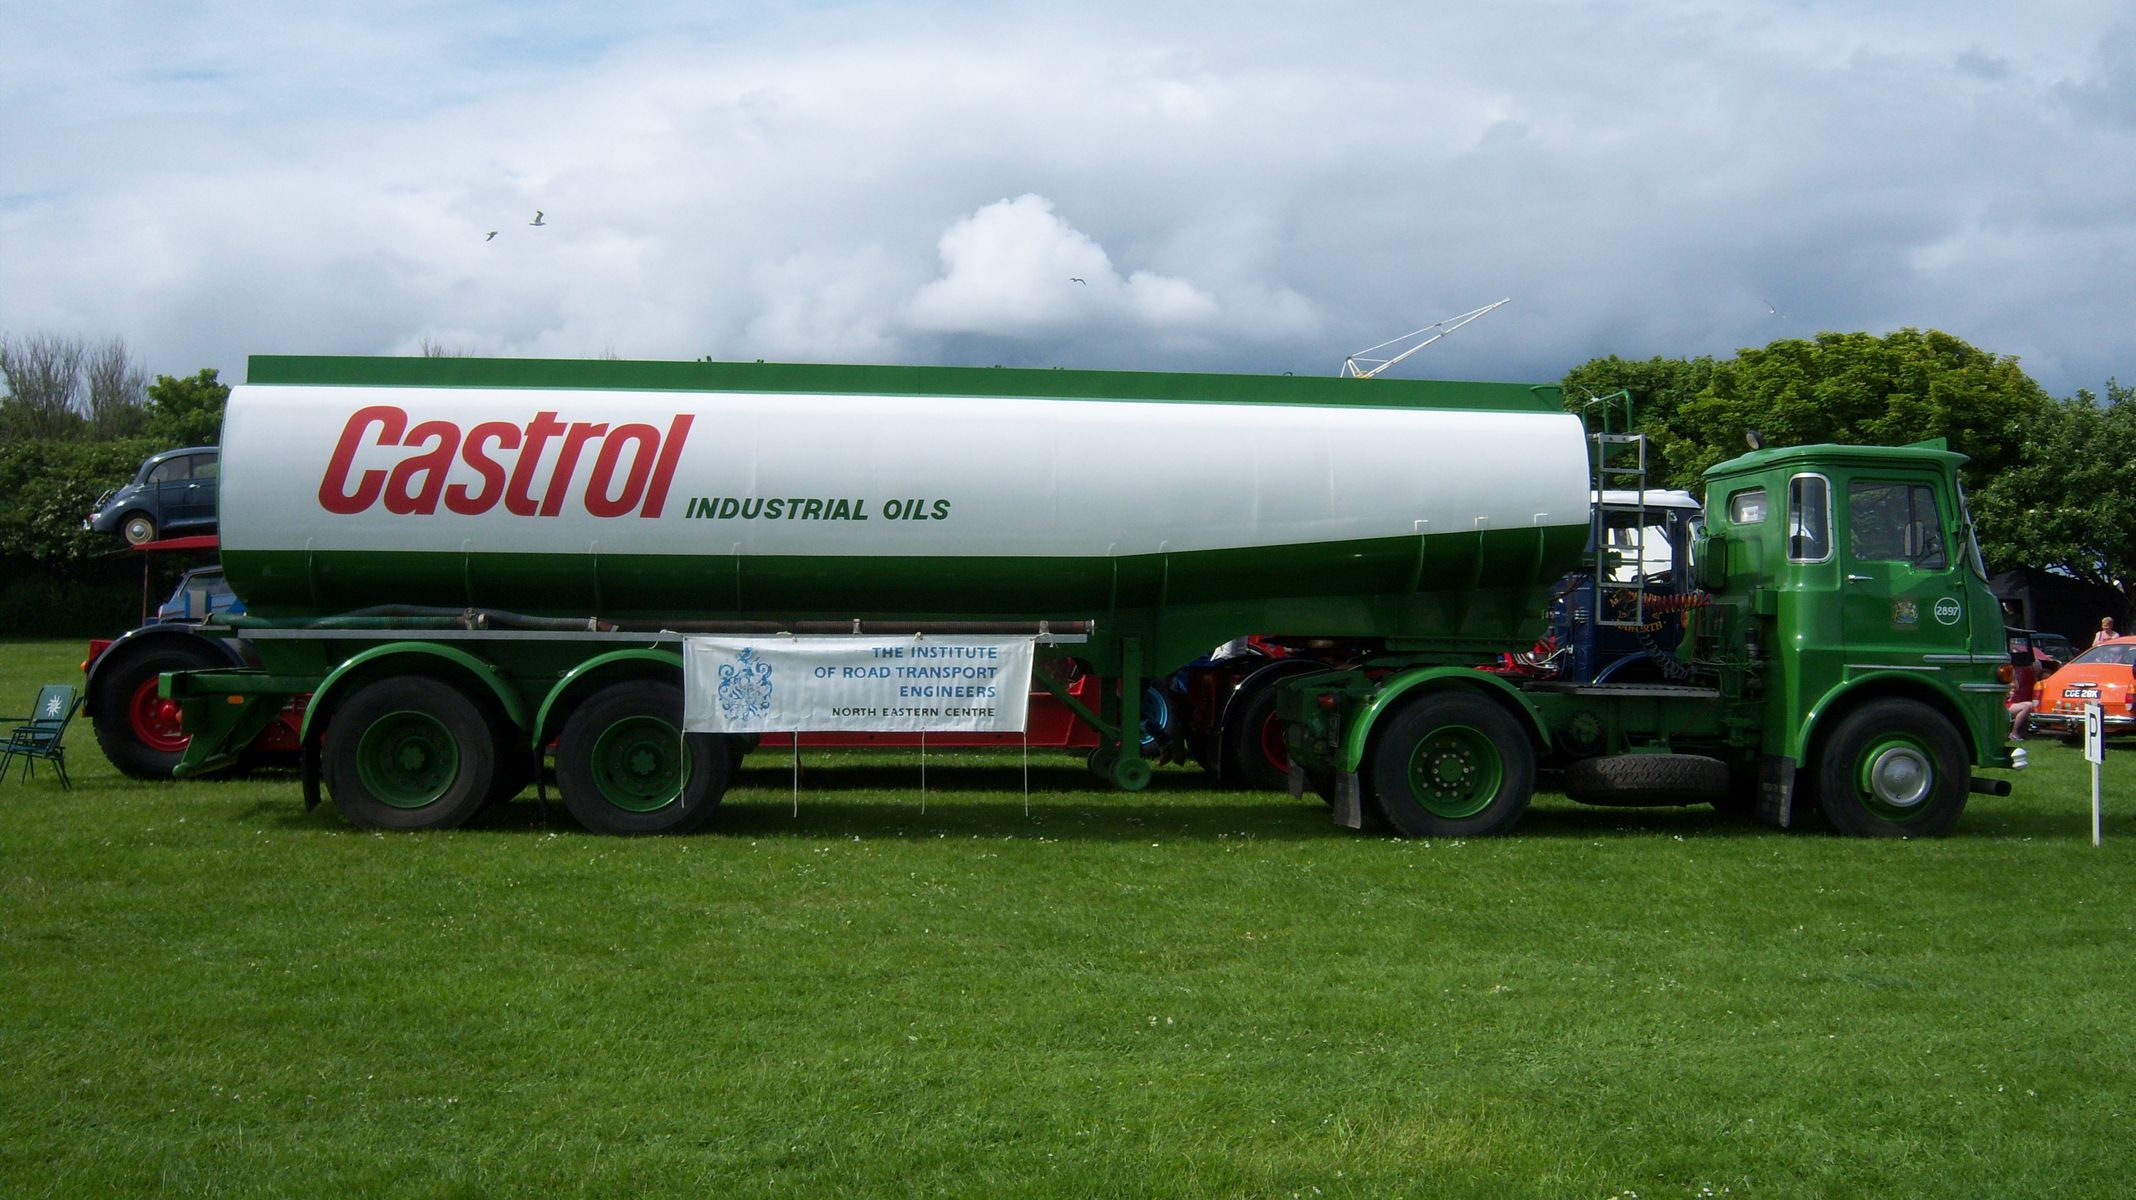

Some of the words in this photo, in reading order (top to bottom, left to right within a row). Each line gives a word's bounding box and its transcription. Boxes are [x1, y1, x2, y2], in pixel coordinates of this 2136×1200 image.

[318, 405, 696, 518] Castrol
[685, 497, 869, 521] INDUSTRIAL
[882, 499, 951, 521] OILS
[1936, 606, 1959, 616] 2897
[872, 647, 904, 659] THE
[911, 647, 998, 659] INSTITUTE
[814, 666, 837, 679] OF
[843, 667, 891, 679] ROAD
[896, 667, 998, 680] TRANSPORT
[900, 686, 996, 698] ENGINEERS
[832, 707, 876, 717] NORTH
[882, 707, 939, 717] EASTERN
[945, 707, 996, 717] CENTRE
[2089, 712, 2098, 757] P
